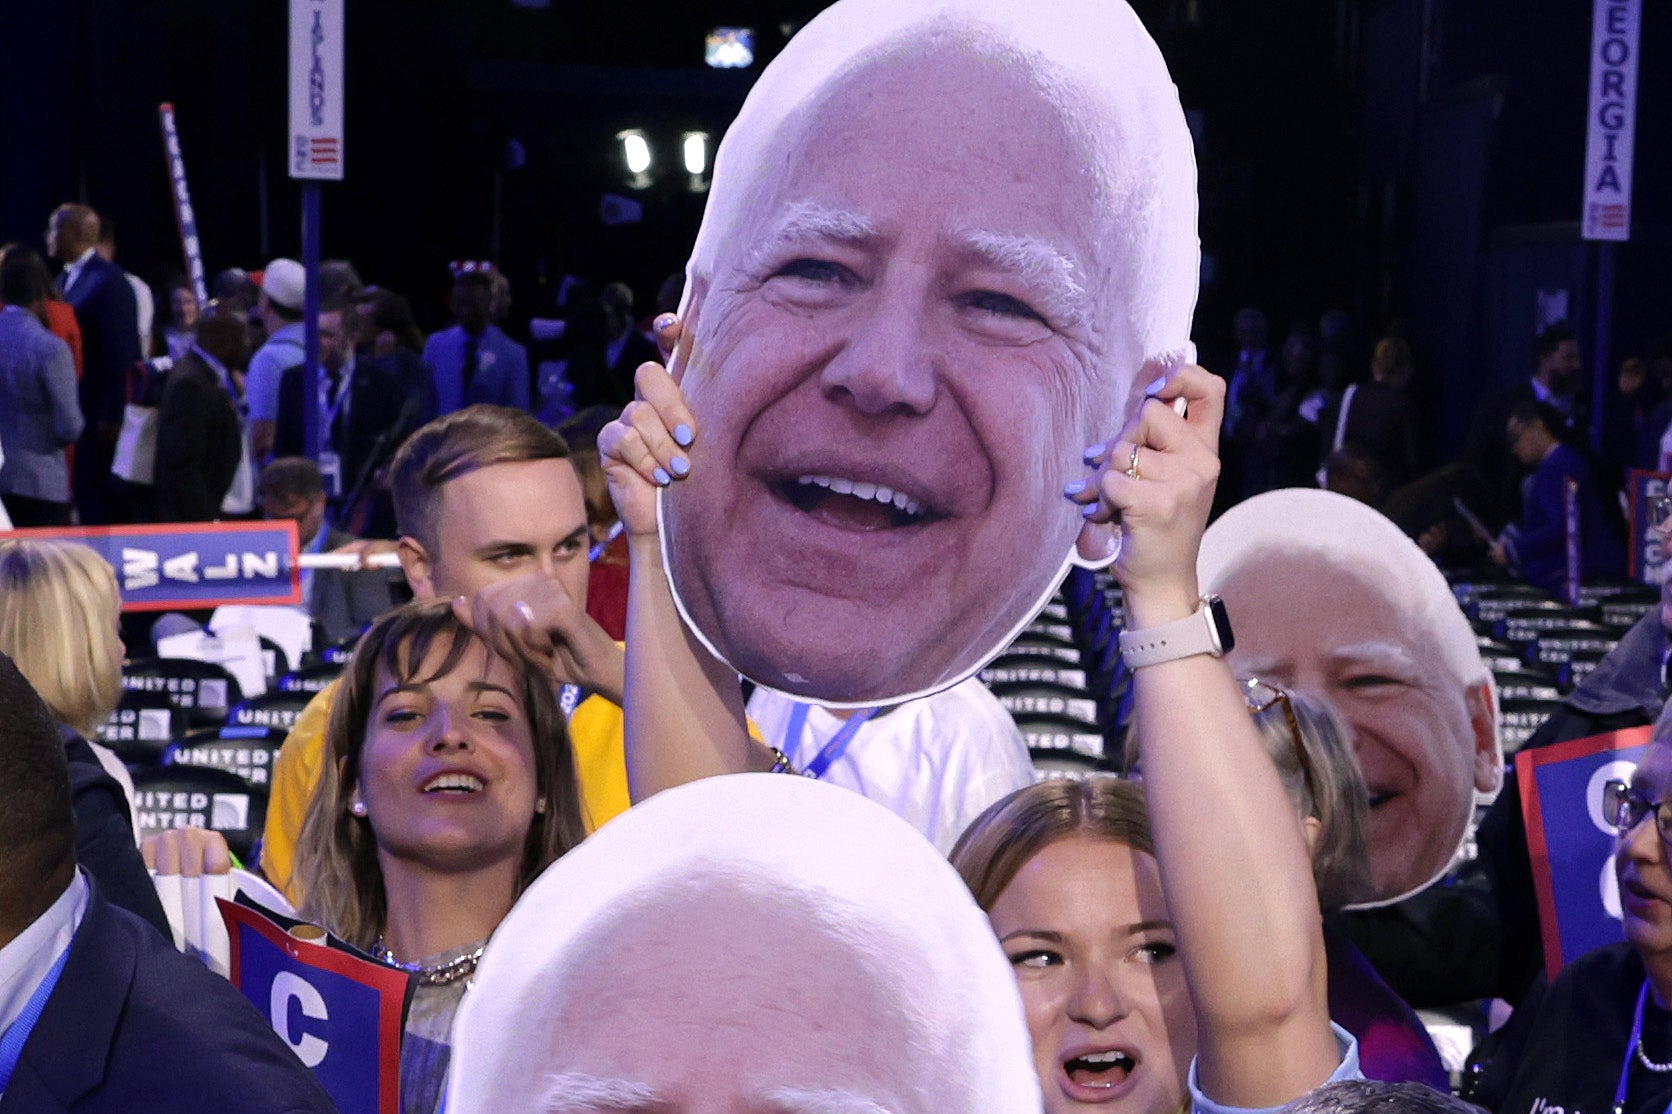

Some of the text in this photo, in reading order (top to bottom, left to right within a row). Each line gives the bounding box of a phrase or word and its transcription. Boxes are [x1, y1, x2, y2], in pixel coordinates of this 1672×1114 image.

[1597, 0, 1629, 193] EORGIA
[121, 547, 279, 591] WALZ
[174, 749, 270, 766] UNITED
[270, 970, 329, 1068] C
